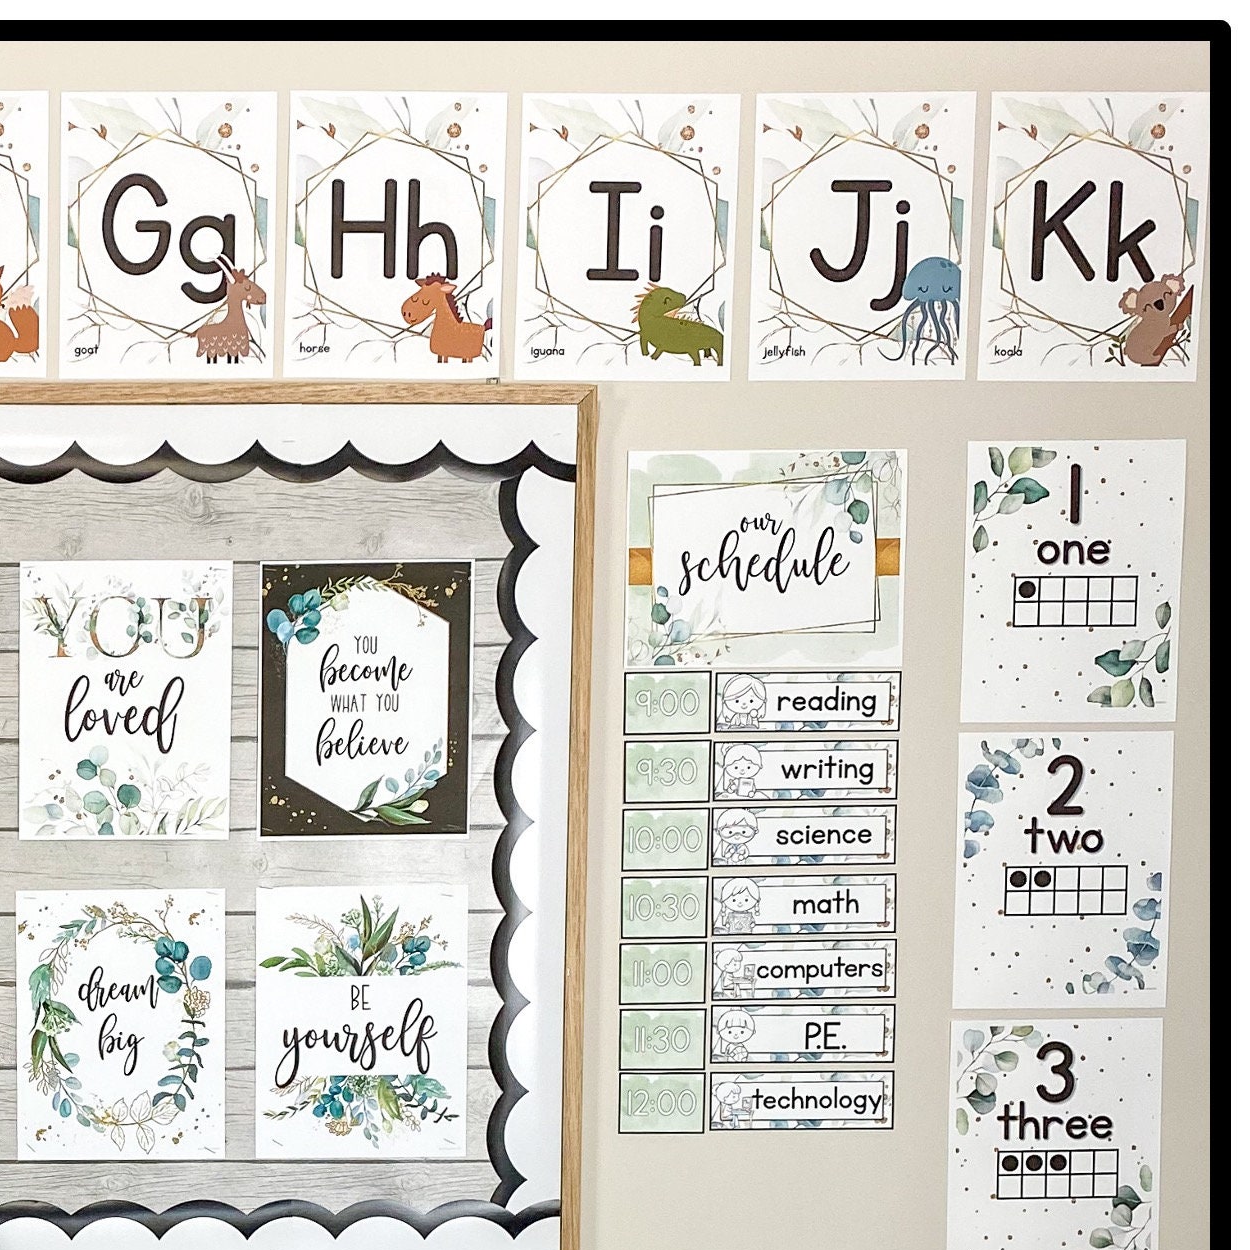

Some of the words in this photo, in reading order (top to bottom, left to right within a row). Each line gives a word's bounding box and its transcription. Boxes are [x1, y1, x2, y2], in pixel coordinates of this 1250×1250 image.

[101, 173, 236, 304] Gg
[332, 178, 459, 280] Hh
[587, 181, 665, 283] Ii
[809, 179, 912, 312] Jj
[1031, 179, 1158, 283] Kk
[74, 344, 100, 356] goat
[299, 343, 331, 353] horse
[530, 346, 565, 358] iguana
[762, 345, 806, 359] jellyfish
[994, 346, 1023, 356] koala
[1071, 463, 1081, 524] 1
[740, 513, 783, 537] our
[679, 526, 851, 596] schedule
[1036, 535, 1111, 565] one
[33, 596, 214, 658] YOU
[354, 635, 378, 655] YOU
[104, 669, 144, 691] are
[320, 643, 414, 693] become
[64, 674, 185, 755] loved
[330, 693, 366, 713] WHAT
[376, 692, 400, 712] YOU
[635, 688, 699, 718] 9:00
[776, 687, 877, 716] reading
[315, 718, 410, 766] believe
[635, 757, 698, 786] 9:30
[781, 758, 874, 785] writing
[1047, 755, 1084, 816] 2
[628, 825, 702, 854] 10:00
[776, 823, 873, 846] science
[1024, 816, 1105, 854] two
[629, 892, 700, 922] 10:30
[792, 889, 860, 915] math
[78, 966, 159, 1012] dream
[633, 959, 693, 988] 11:00
[756, 959, 883, 984] computers
[350, 984, 371, 1011] BE
[98, 1013, 145, 1077] big
[274, 998, 438, 1089] yourself
[634, 1025, 691, 1054] 11:30
[805, 1022, 847, 1051] P.E.
[1036, 1041, 1076, 1103] 3
[627, 1089, 697, 1117] 12:00
[752, 1087, 882, 1116] technology
[997, 1102, 1114, 1140] three
